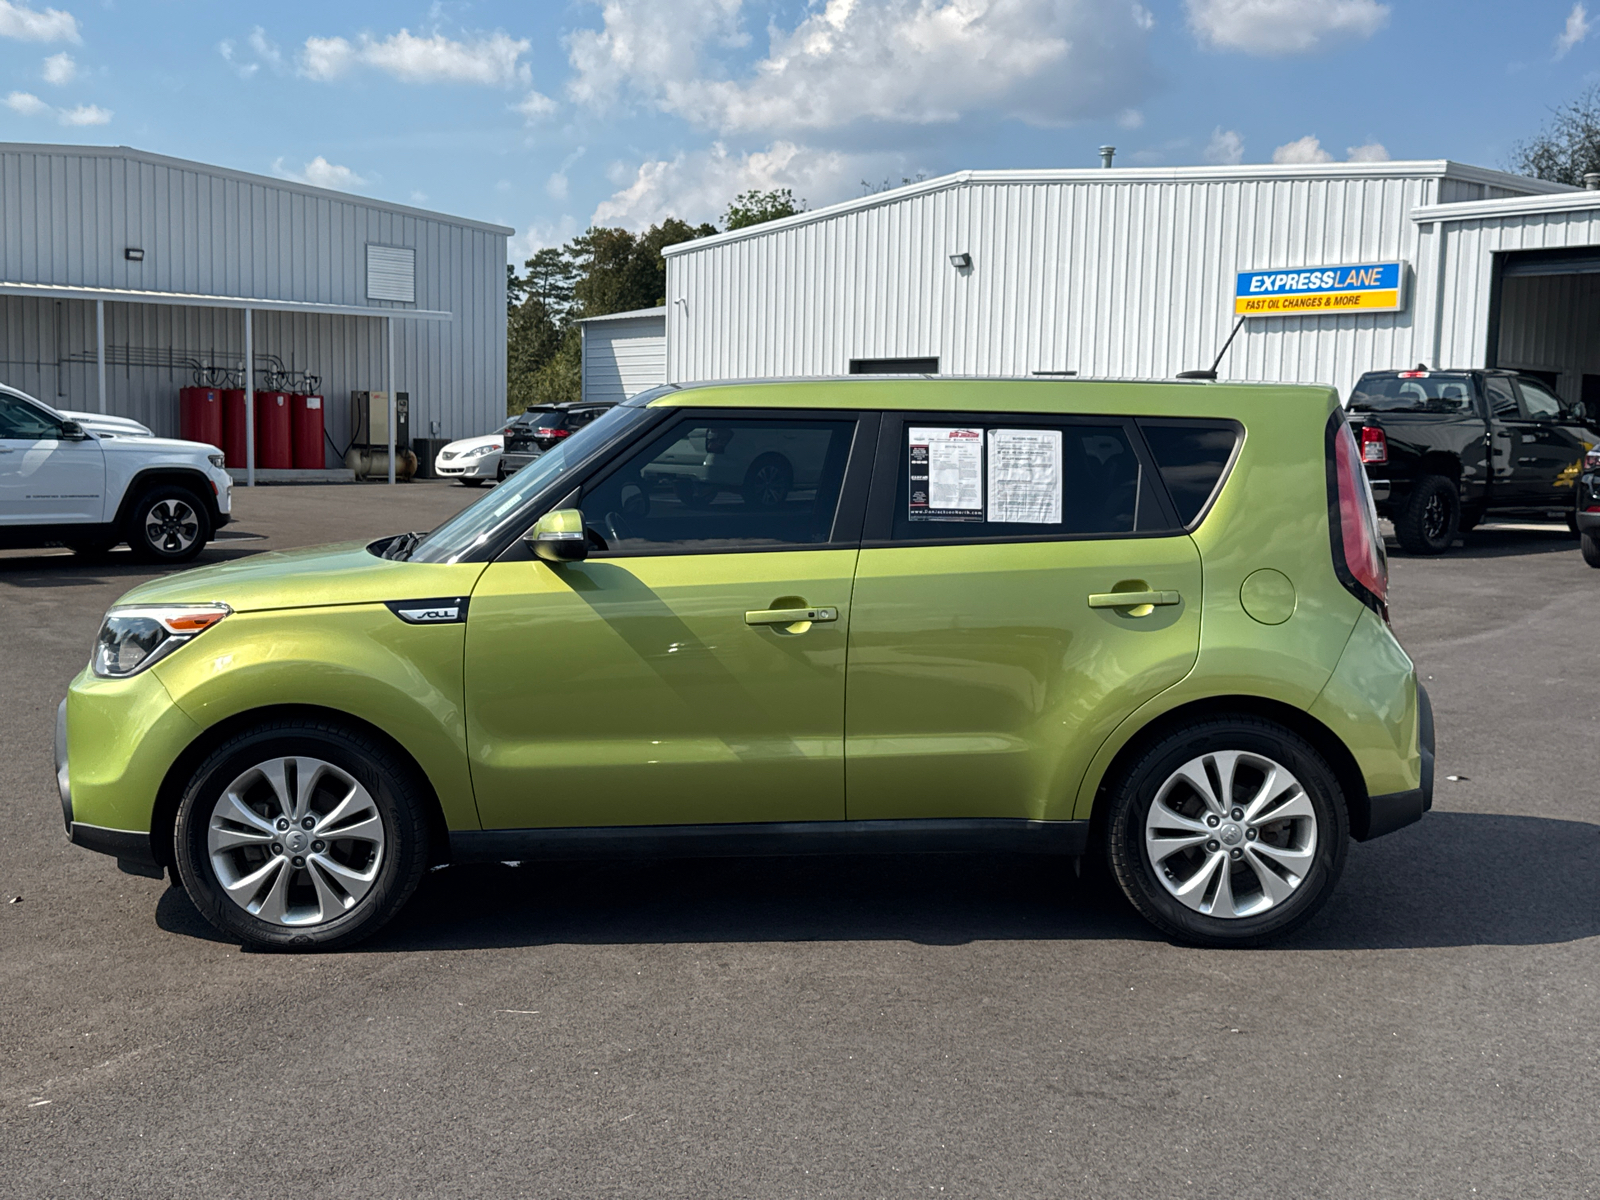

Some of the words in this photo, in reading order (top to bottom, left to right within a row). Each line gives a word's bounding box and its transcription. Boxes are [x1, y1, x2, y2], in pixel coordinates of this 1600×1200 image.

[1249, 267, 1383, 292] EXPRESSLANE
[1245, 300, 1266, 310] FAST
[1267, 299, 1280, 309] OIL
[1282, 297, 1322, 308] CHANGES
[1324, 297, 1331, 306] &
[1333, 295, 1361, 306] MORE
